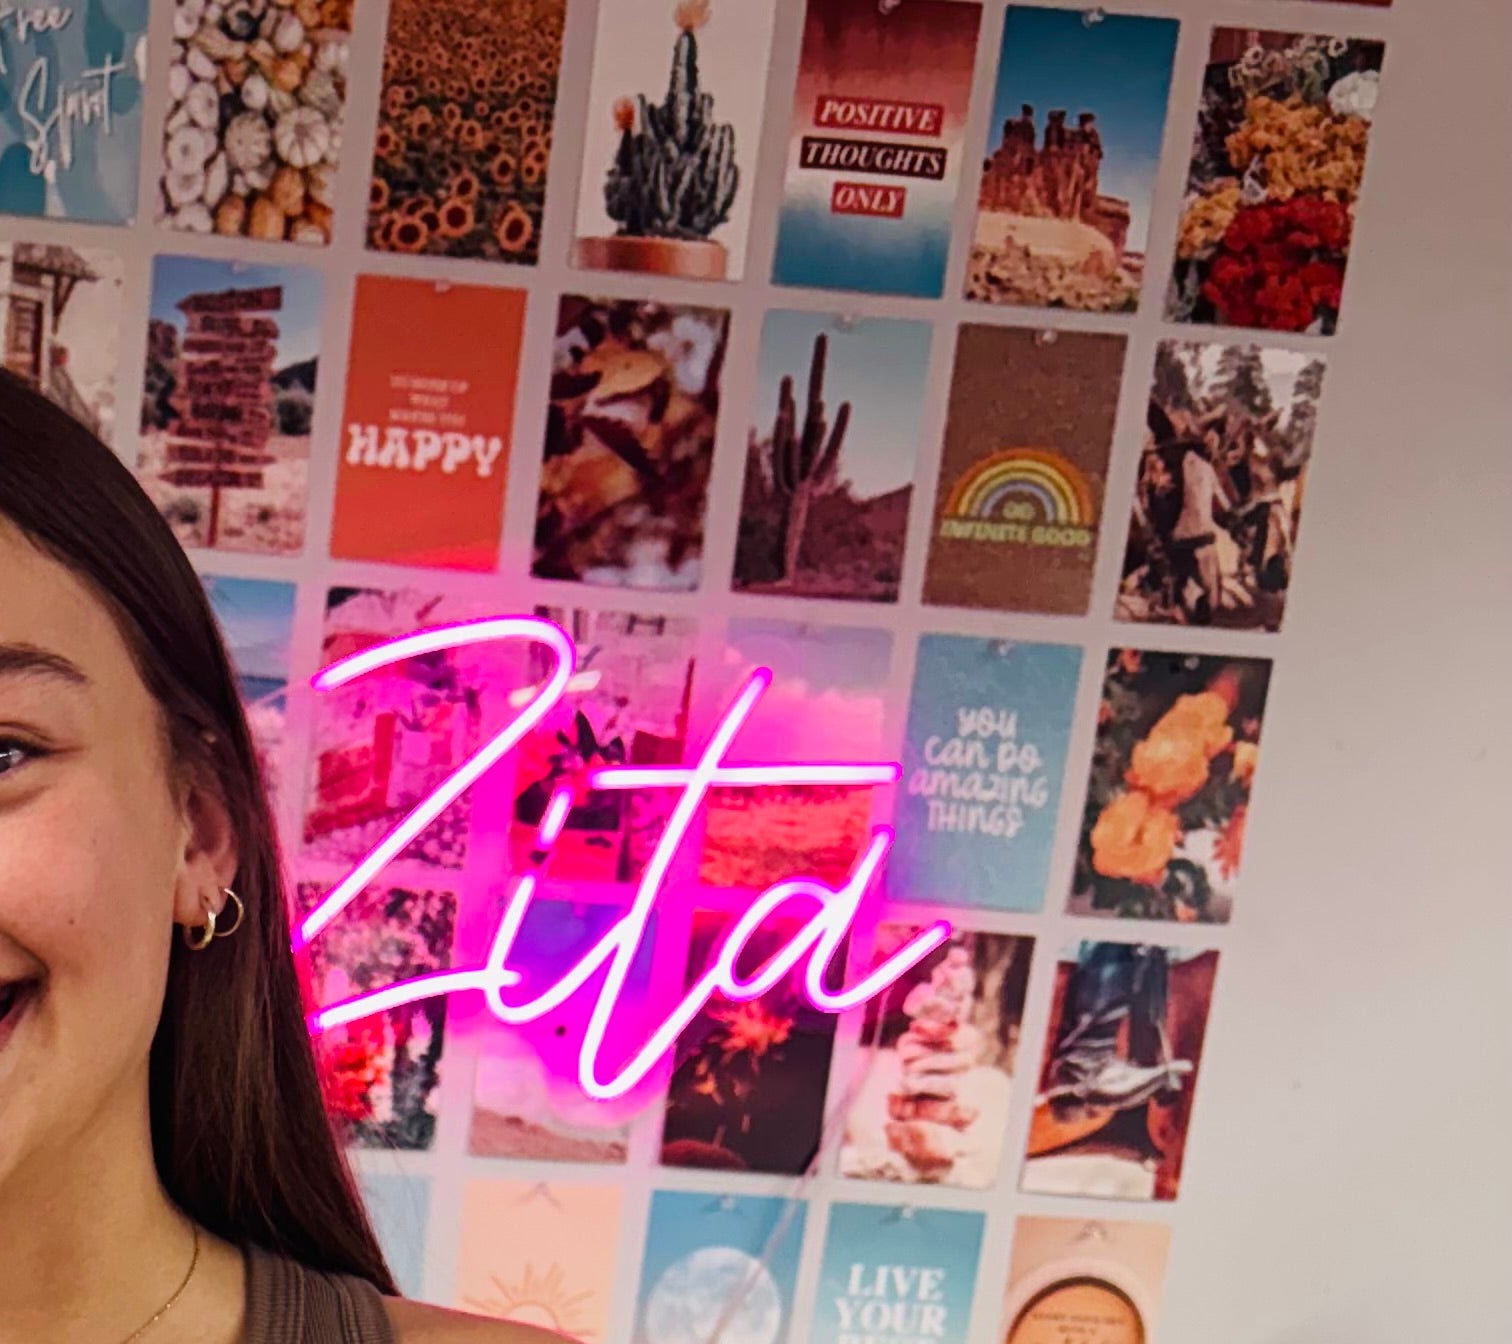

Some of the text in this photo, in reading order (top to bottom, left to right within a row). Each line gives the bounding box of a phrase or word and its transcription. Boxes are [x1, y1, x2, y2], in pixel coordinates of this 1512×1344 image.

[18, 55, 126, 175] Spirit
[819, 99, 938, 132] POSITIVE
[805, 142, 943, 176] THOUGHTS
[835, 184, 902, 212] ONLY
[345, 422, 502, 478] HAPPY
[291, 612, 951, 1101] Zita
[847, 1261, 946, 1302] LIVE
[834, 1298, 949, 1338] YOUR
